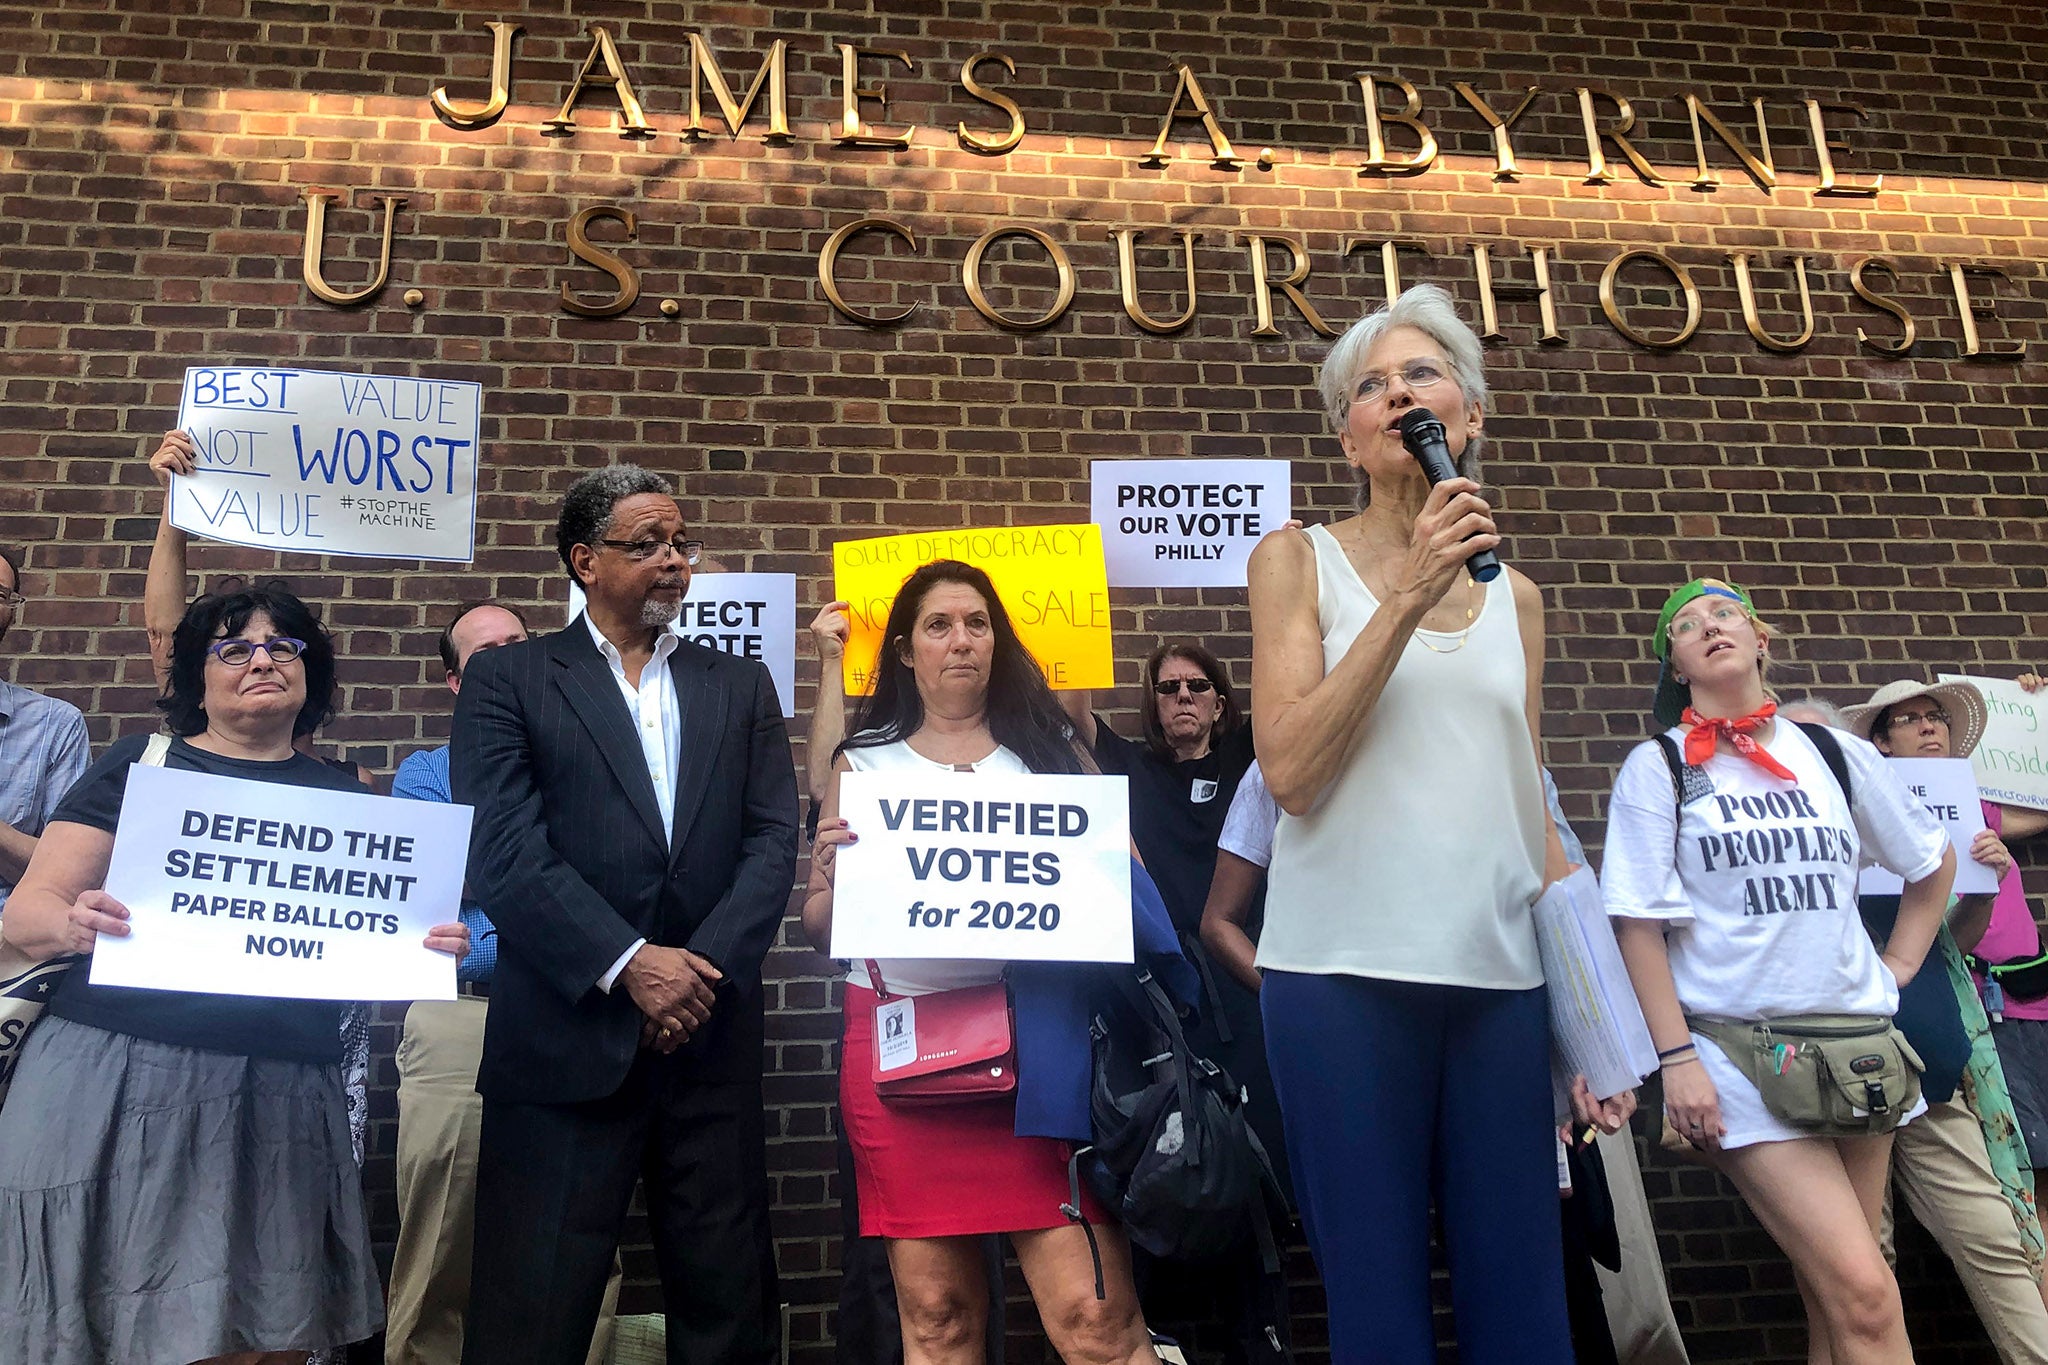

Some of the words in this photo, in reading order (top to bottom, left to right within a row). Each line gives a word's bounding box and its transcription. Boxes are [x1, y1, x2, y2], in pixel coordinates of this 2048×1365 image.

[431, 21, 1026, 152] JAMES
[1141, 63, 1277, 166] A.
[1352, 72, 1884, 193] BYRNE
[298, 194, 424, 305] U.
[561, 205, 681, 317] S.
[818, 217, 2028, 360] COURTHOUSE
[194, 369, 300, 408] BEST
[340, 376, 460, 424] VALUE
[187, 426, 269, 467] NOT
[292, 424, 471, 494] WORST
[188, 488, 324, 538] VALUE
[1117, 484, 1264, 508] PROTECT
[359, 513, 436, 531] MACHINE
[1119, 516, 1169, 534] OUR
[1176, 513, 1261, 537] VOTE
[844, 541, 900, 567] OUR
[915, 529, 1087, 561] DEMOCRACY
[1155, 544, 1225, 560] PHILLY
[680, 601, 766, 627] TECT
[846, 596, 894, 632] NO
[1020, 590, 1108, 628] SALE
[683, 633, 762, 660] OTE
[1985, 690, 2037, 732] ting
[879, 798, 1089, 837] VERIFIED
[1715, 789, 1819, 823] POOR
[181, 809, 334, 853] DEFEND
[343, 830, 415, 863] THE
[1698, 826, 1853, 873] PEOPLE'S
[164, 849, 418, 902] SETTLEMENT
[905, 847, 1061, 886] VOTES
[170, 892, 266, 921] PAPER
[272, 902, 400, 934] BALLOTS
[1744, 873, 1839, 916] ARMY
[908, 901, 960, 927] for
[968, 900, 1061, 931] 2020
[245, 934, 324, 960] NOW!
